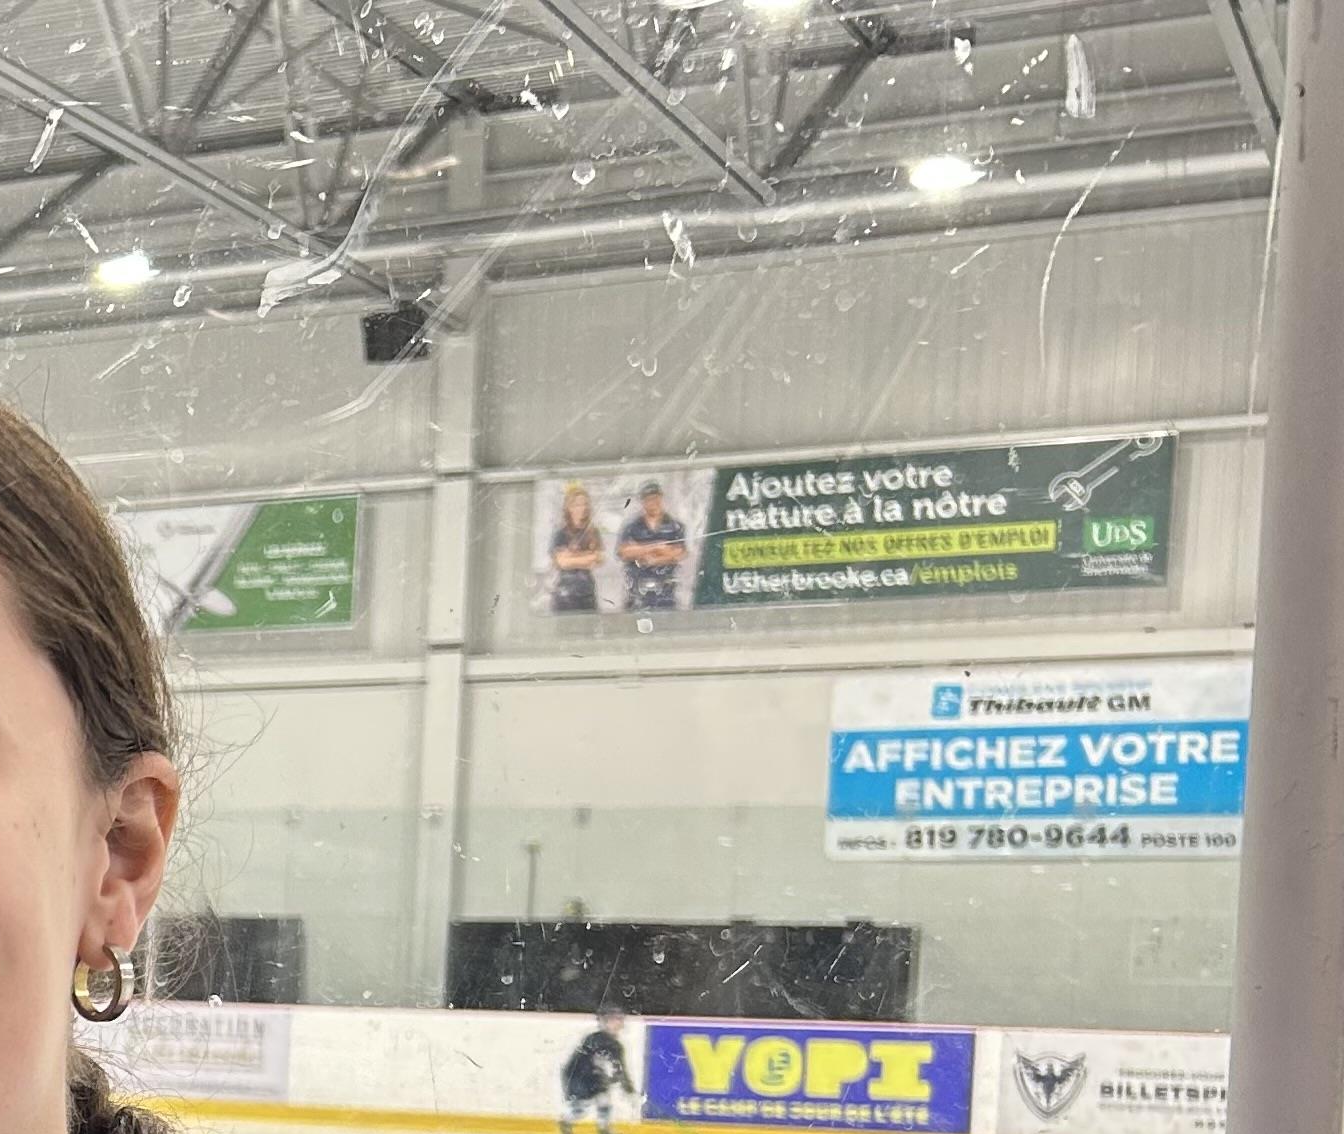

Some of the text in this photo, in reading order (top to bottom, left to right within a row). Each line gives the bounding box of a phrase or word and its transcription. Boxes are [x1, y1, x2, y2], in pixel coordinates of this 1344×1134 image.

[725, 462, 954, 506] Ajoutez votre
[725, 490, 1008, 530] nature à la nôtre
[882, 531, 954, 554] OFFRES
[957, 526, 1050, 550] D'EMPLOI
[969, 692, 1152, 716] Thibault GM
[842, 730, 1241, 774] AFFICHEZ VOTRE
[896, 772, 1180, 812] ENTREPRISE
[904, 826, 957, 850] 819
[967, 823, 1131, 850] 780-9644
[1139, 831, 1199, 849] POSTE
[1204, 831, 1238, 848] 100
[680, 1033, 934, 1102] YOPI
